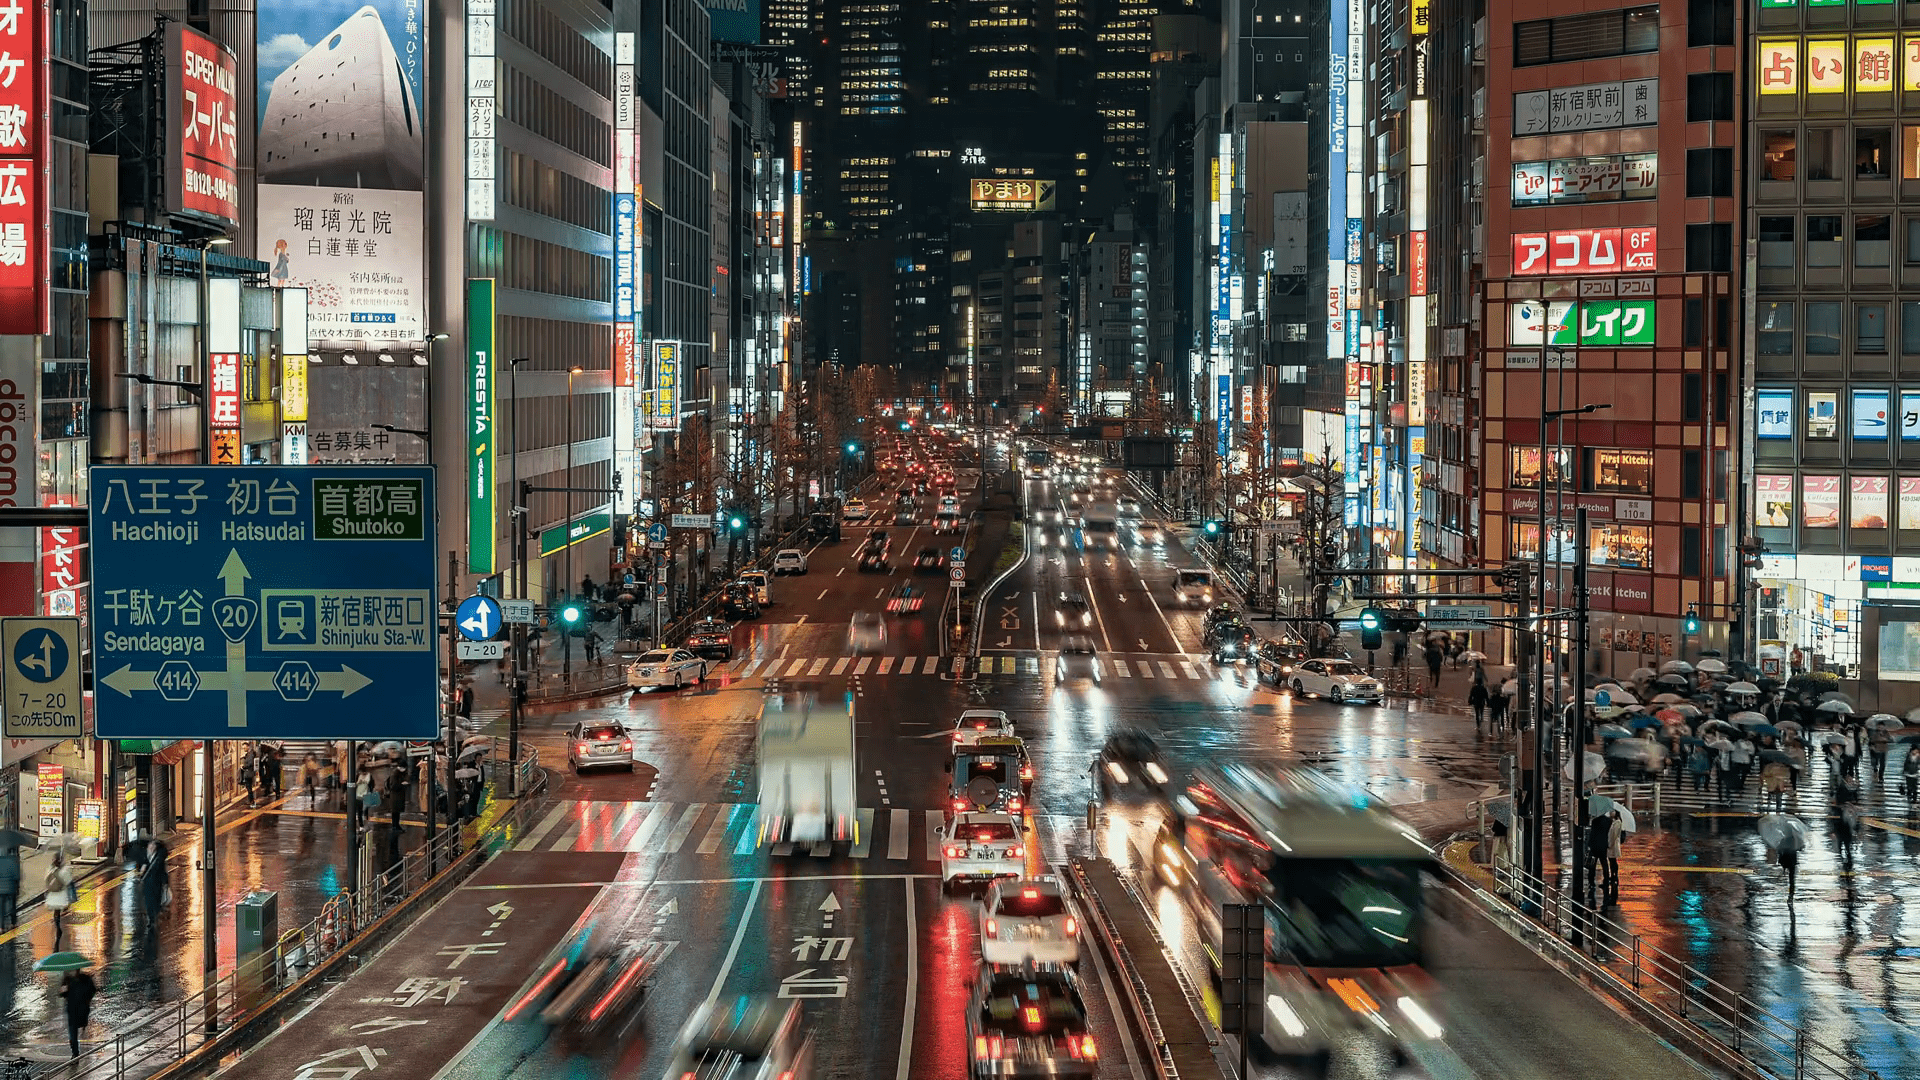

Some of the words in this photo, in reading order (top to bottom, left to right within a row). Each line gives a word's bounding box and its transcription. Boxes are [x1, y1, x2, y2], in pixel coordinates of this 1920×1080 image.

[185, 50, 214, 86] SUPER
[1763, 51, 1891, 86] 占い館
[470, 99, 493, 108] KEN
[620, 84, 630, 122] Bloom
[1551, 86, 1621, 113] 新宿駅前
[1634, 84, 1648, 121] 歯科
[472, 109, 480, 136] スクール
[483, 109, 491, 136] パソコン
[1332, 103, 1345, 132] Your
[1526, 109, 1623, 132] デンタルクリニック
[1332, 132, 1345, 153] For
[976, 181, 1032, 199] やまや
[1551, 170, 1655, 194] エーアイアール
[332, 192, 354, 206] 新宿
[293, 206, 392, 235] 瑠璃光院
[1348, 219, 1361, 231] 6F
[618, 213, 632, 252] JAPAN
[1630, 232, 1651, 249] 6F
[307, 236, 378, 258] 白蓮華堂
[1521, 231, 1616, 271] アコム
[618, 252, 632, 287] TOTAL
[1638, 254, 1654, 268] 入口
[1583, 282, 1613, 295] アコム
[1621, 280, 1651, 294] アコム
[1329, 287, 1339, 317] LABI
[1581, 307, 1646, 338] レイク
[624, 329, 633, 386] パソコンスクール
[1347, 364, 1359, 395] トレカ
[213, 364, 238, 422] 指圧
[17, 403, 26, 422] NTT
[1760, 410, 1789, 425] 賃貸
[285, 425, 305, 436] KM
[1601, 454, 1620, 465] First
[101, 479, 209, 516] 八王子
[225, 478, 301, 516] 初台
[318, 484, 418, 517] 首都高
[1512, 496, 1539, 511] Wendy's
[111, 521, 199, 545] Hachioji
[221, 521, 306, 541] Hatsudai
[331, 517, 406, 535] Shutoko
[1600, 533, 1619, 544] First
[1861, 564, 1889, 572] PROMISE
[1603, 586, 1647, 600] Kitchen
[221, 604, 249, 628] 20
[320, 595, 426, 627] 新宿駅西口
[1433, 609, 1486, 619] 西新宿一丁目
[103, 631, 206, 656] Sendagaya
[320, 628, 380, 649] Shinjuku
[383, 628, 426, 646] Sta.-W.
[161, 671, 193, 691] 414
[280, 671, 312, 691] 414
[11, 712, 76, 728] この先50m
[777, 935, 854, 999] 初台
